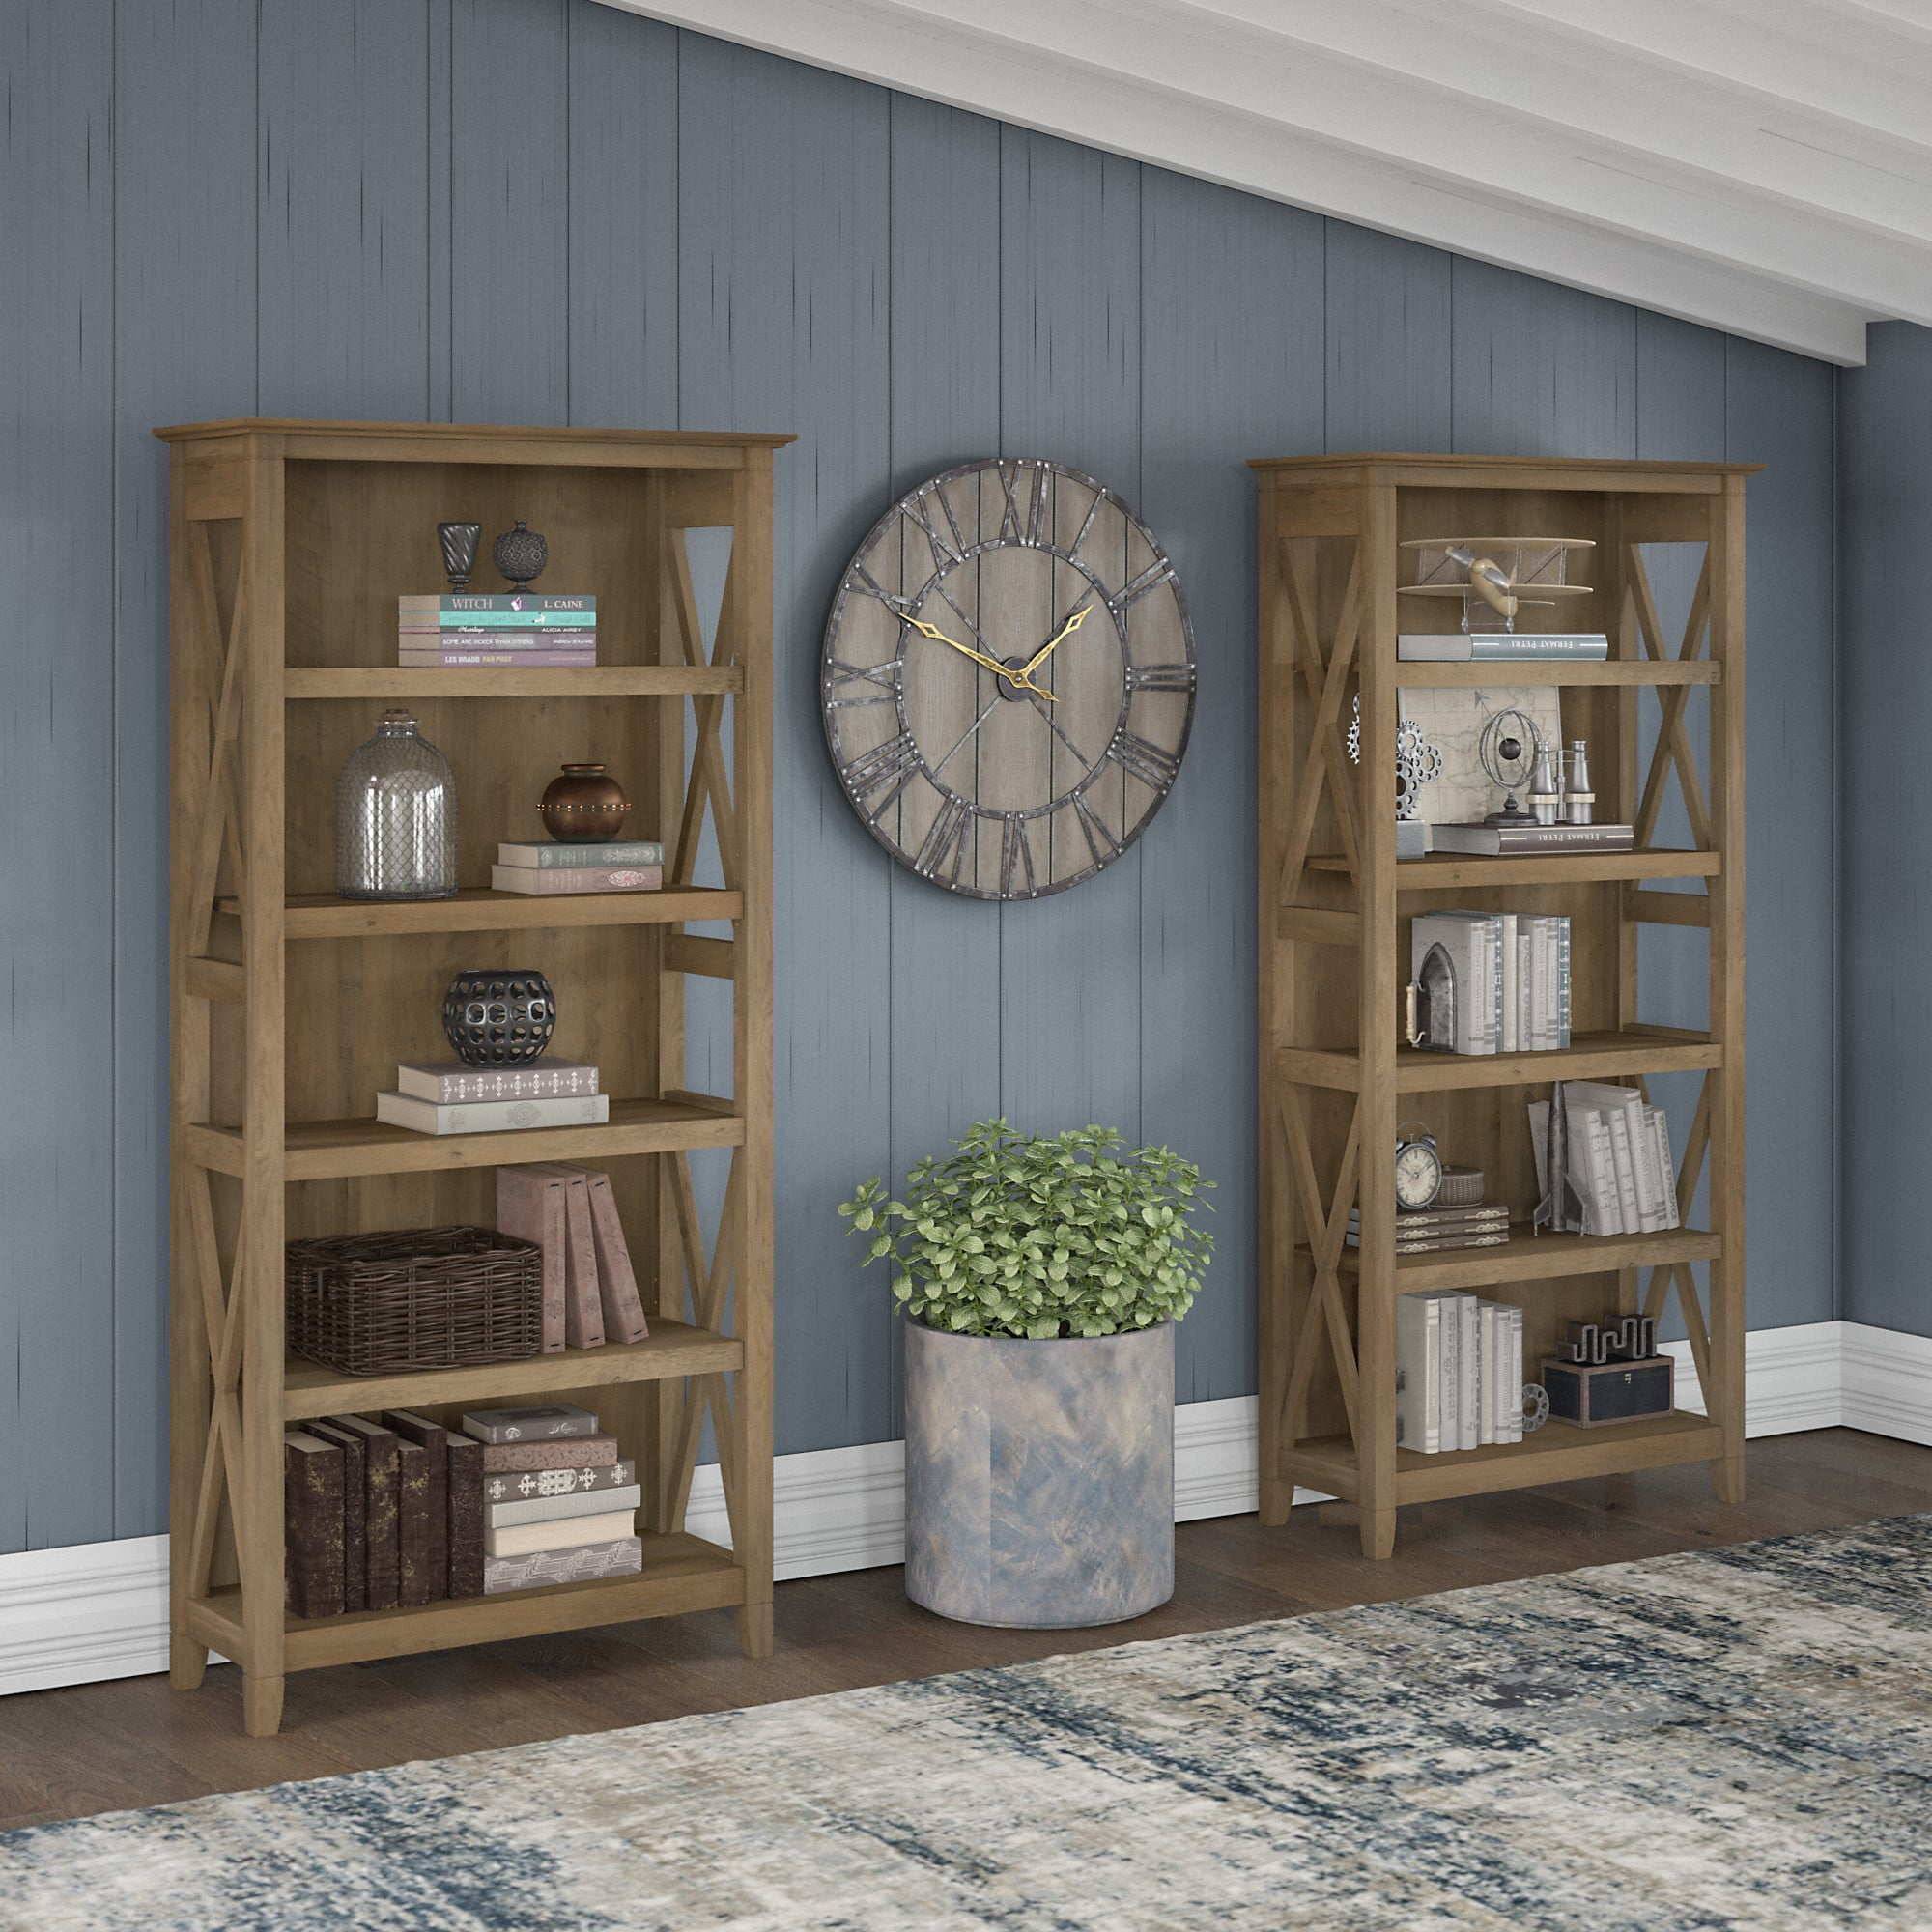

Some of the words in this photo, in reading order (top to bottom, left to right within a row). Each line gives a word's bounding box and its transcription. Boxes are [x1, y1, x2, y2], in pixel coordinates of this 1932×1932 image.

[451, 597, 493, 610] WITCH
[544, 600, 553, 609] L.
[554, 600, 584, 609] CAINE
